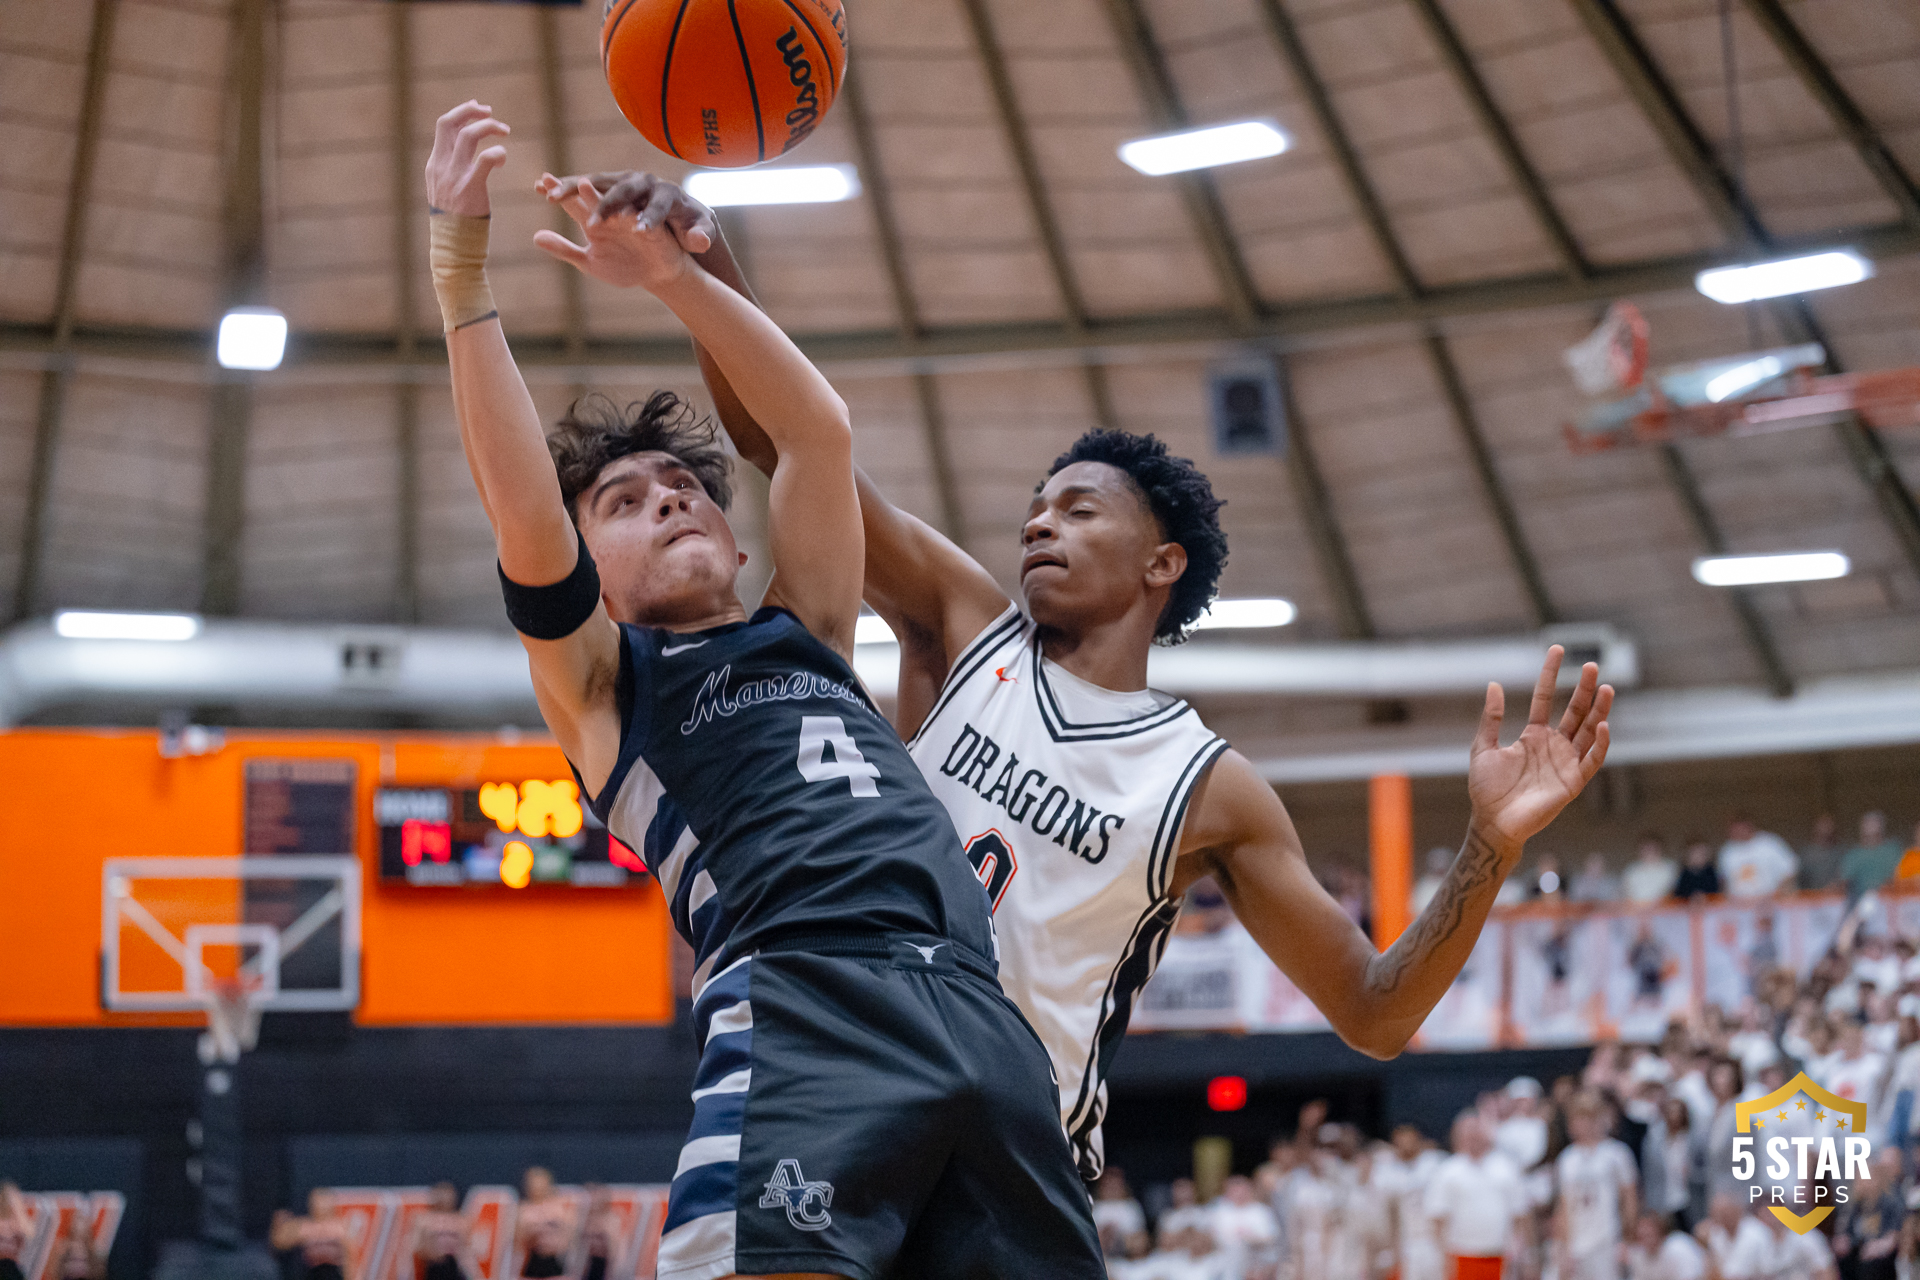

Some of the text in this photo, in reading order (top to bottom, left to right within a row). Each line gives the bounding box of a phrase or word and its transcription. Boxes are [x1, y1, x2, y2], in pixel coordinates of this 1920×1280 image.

[680, 663, 881, 736] Maveric
[796, 715, 882, 798] 4
[939, 722, 1126, 865] DRAGONS
